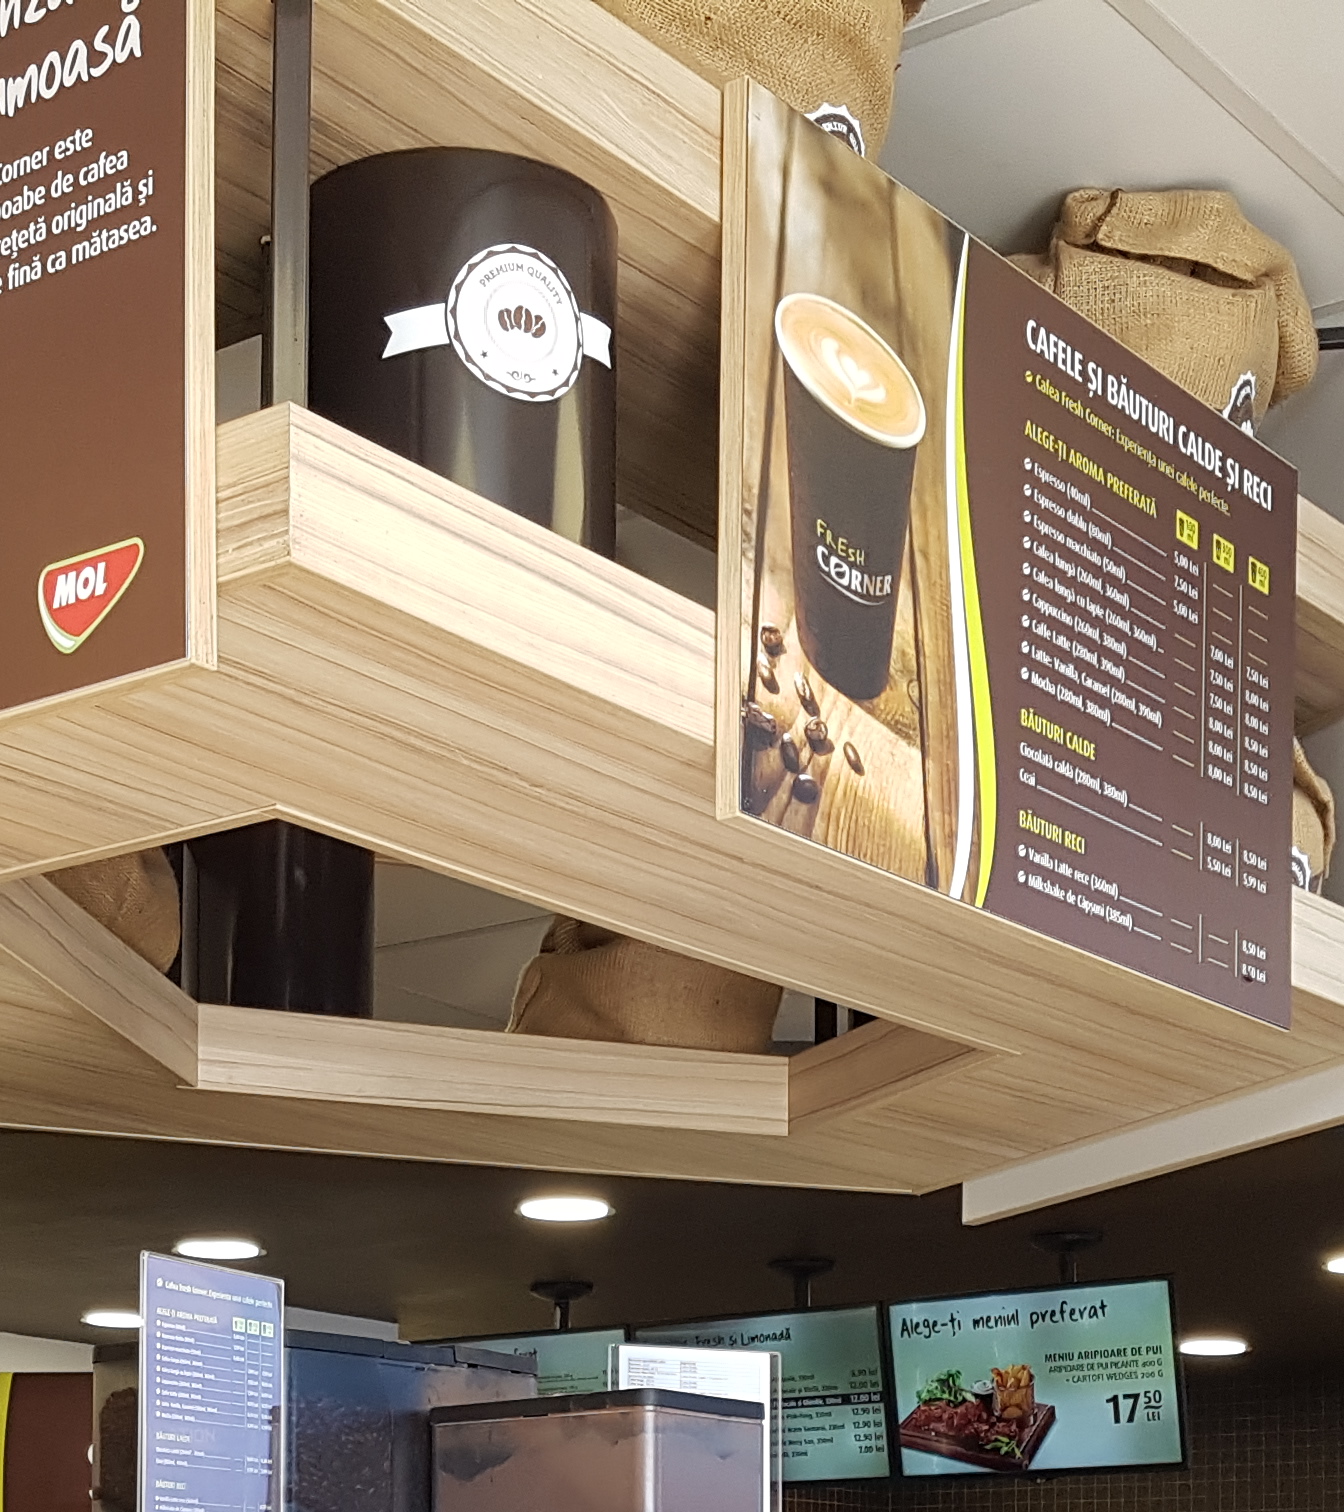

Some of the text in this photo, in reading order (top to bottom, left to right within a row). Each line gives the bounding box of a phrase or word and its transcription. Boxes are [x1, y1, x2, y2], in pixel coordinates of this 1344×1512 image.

[55, 128, 93, 161] este
[51, 170, 73, 199] de
[79, 150, 128, 188] cafea
[52, 181, 133, 233] originală
[8, 256, 42, 290] fină
[47, 250, 67, 275] ca
[71, 214, 158, 264] mătasea.
[479, 263, 562, 305] PREMIUM QUALITY
[1026, 319, 1272, 511] CAFELE ȘI BĂUTURI CALDE ȘI RECI
[1061, 391, 1084, 419] Fresh
[1034, 463, 1065, 493] Espresso
[1069, 448, 1105, 486] AROMA
[1107, 472, 1157, 519] PREFERATĂ
[1034, 488, 1065, 518] Espresso
[816, 519, 865, 566] FRESH
[1033, 515, 1064, 544] Espresso
[52, 562, 108, 609] MOL
[1031, 671, 1056, 695] Mocha
[1020, 708, 1096, 761] BĂUTURI CALDE
[1019, 768, 1036, 788] Ceai
[1019, 810, 1085, 855] BĂUTURI RECI
[1028, 873, 1065, 900] Milkshake
[1067, 890, 1076, 905] de
[1074, 869, 1089, 885] rece
[900, 1300, 1107, 1338] Alege-ți meniul preferat
[1045, 1345, 1162, 1363] MENIU ARIPIOARE DE PUI
[1106, 1393, 1140, 1425] 17
[1143, 1390, 1162, 1405] 50
[1146, 1410, 1161, 1422] LEI
